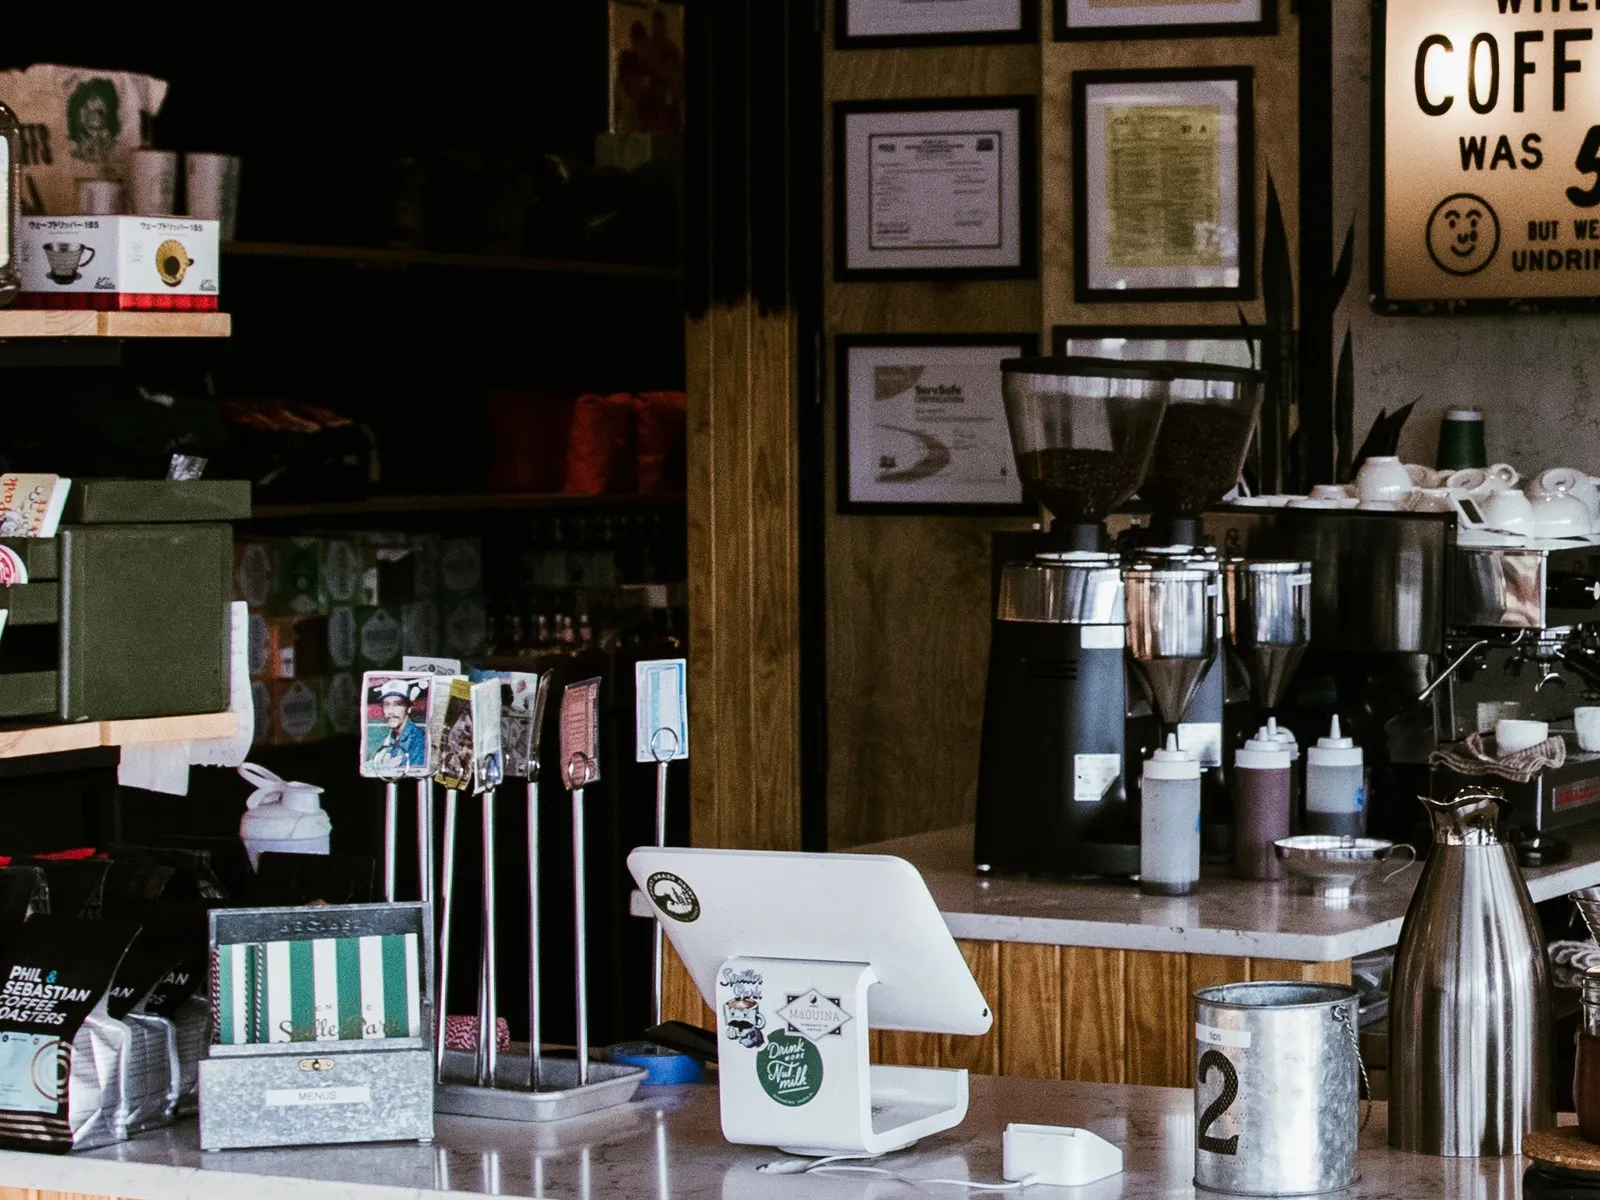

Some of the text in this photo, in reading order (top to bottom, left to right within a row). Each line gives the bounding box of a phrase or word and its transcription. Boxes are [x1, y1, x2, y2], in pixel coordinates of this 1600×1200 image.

[1459, 133, 1543, 171] WAS
[1527, 220, 1559, 241] BUT
[9, 965, 58, 983] PHIL &
[2, 980, 91, 1002] SEBASTIAN
[1209, 1031, 1222, 1042] tips
[767, 1037, 805, 1059] Drink
[785, 1052, 805, 1061] MORE
[767, 1060, 800, 1083] Nut
[779, 1064, 808, 1089] milk
[298, 1091, 337, 1101] MENUS
[1198, 1050, 1240, 1155] 2
